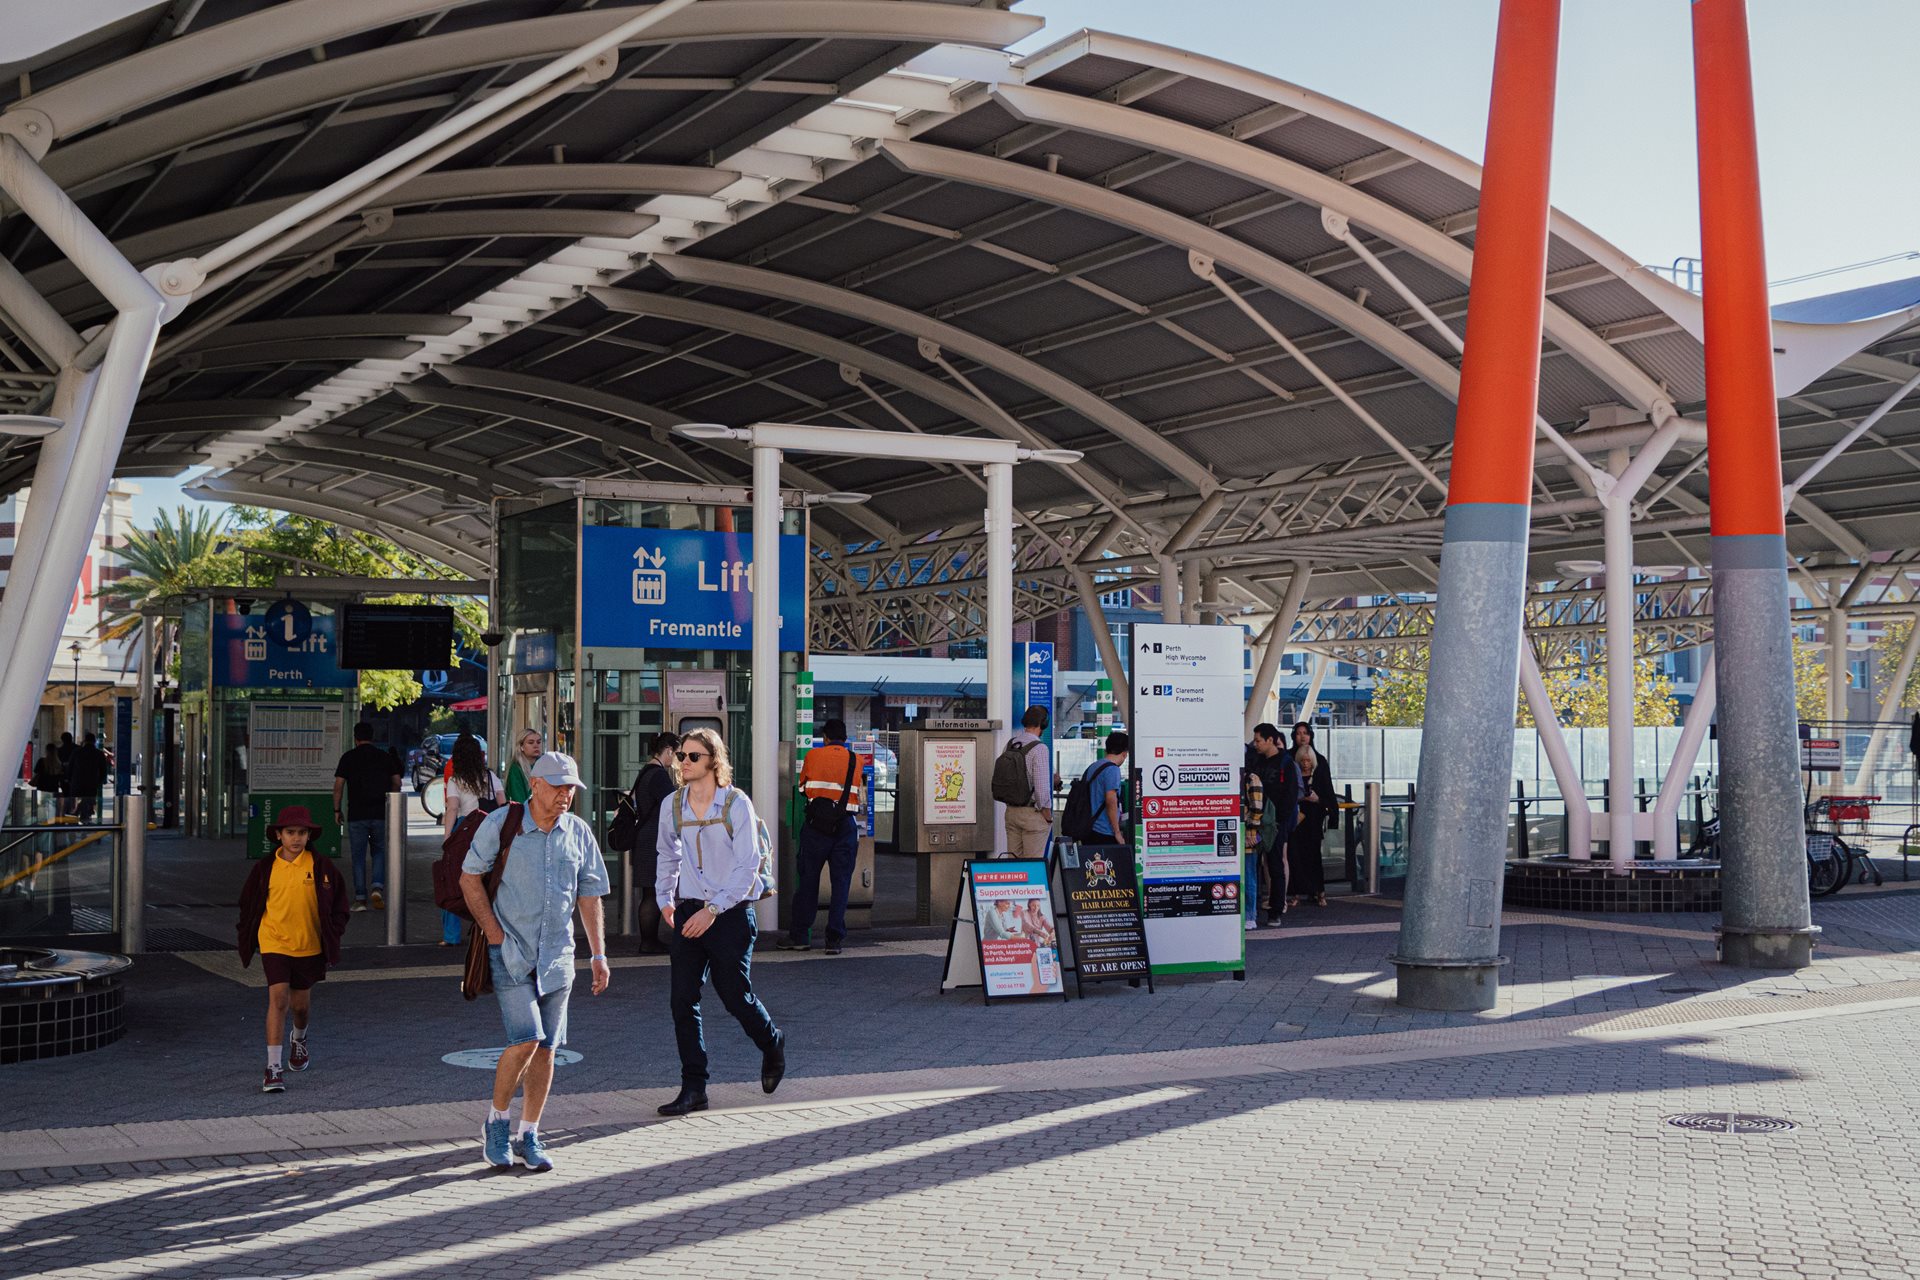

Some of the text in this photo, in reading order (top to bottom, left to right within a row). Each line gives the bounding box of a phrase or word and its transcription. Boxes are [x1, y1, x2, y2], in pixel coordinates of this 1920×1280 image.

[698, 560, 753, 593] Lift
[649, 619, 742, 638] Fremantle
[1165, 654, 1207, 662] High Wycombe
[269, 669, 303, 680] Perth
[887, 696, 911, 705] CAFE
[934, 720, 979, 728] Information
[1179, 773, 1229, 782] SHUTDOWN
[1205, 798, 1233, 806] Cancelled
[262, 799, 272, 853] Infation
[979, 887, 1043, 897] Support Workers
[1148, 885, 1178, 893] Conditions
[1185, 884, 1202, 893] Entry
[1071, 889, 1135, 900] GENTLEMEN'S
[1081, 900, 1131, 910] HAIR LOUNGE
[1083, 960, 1147, 973] WE ARE OPEN!
